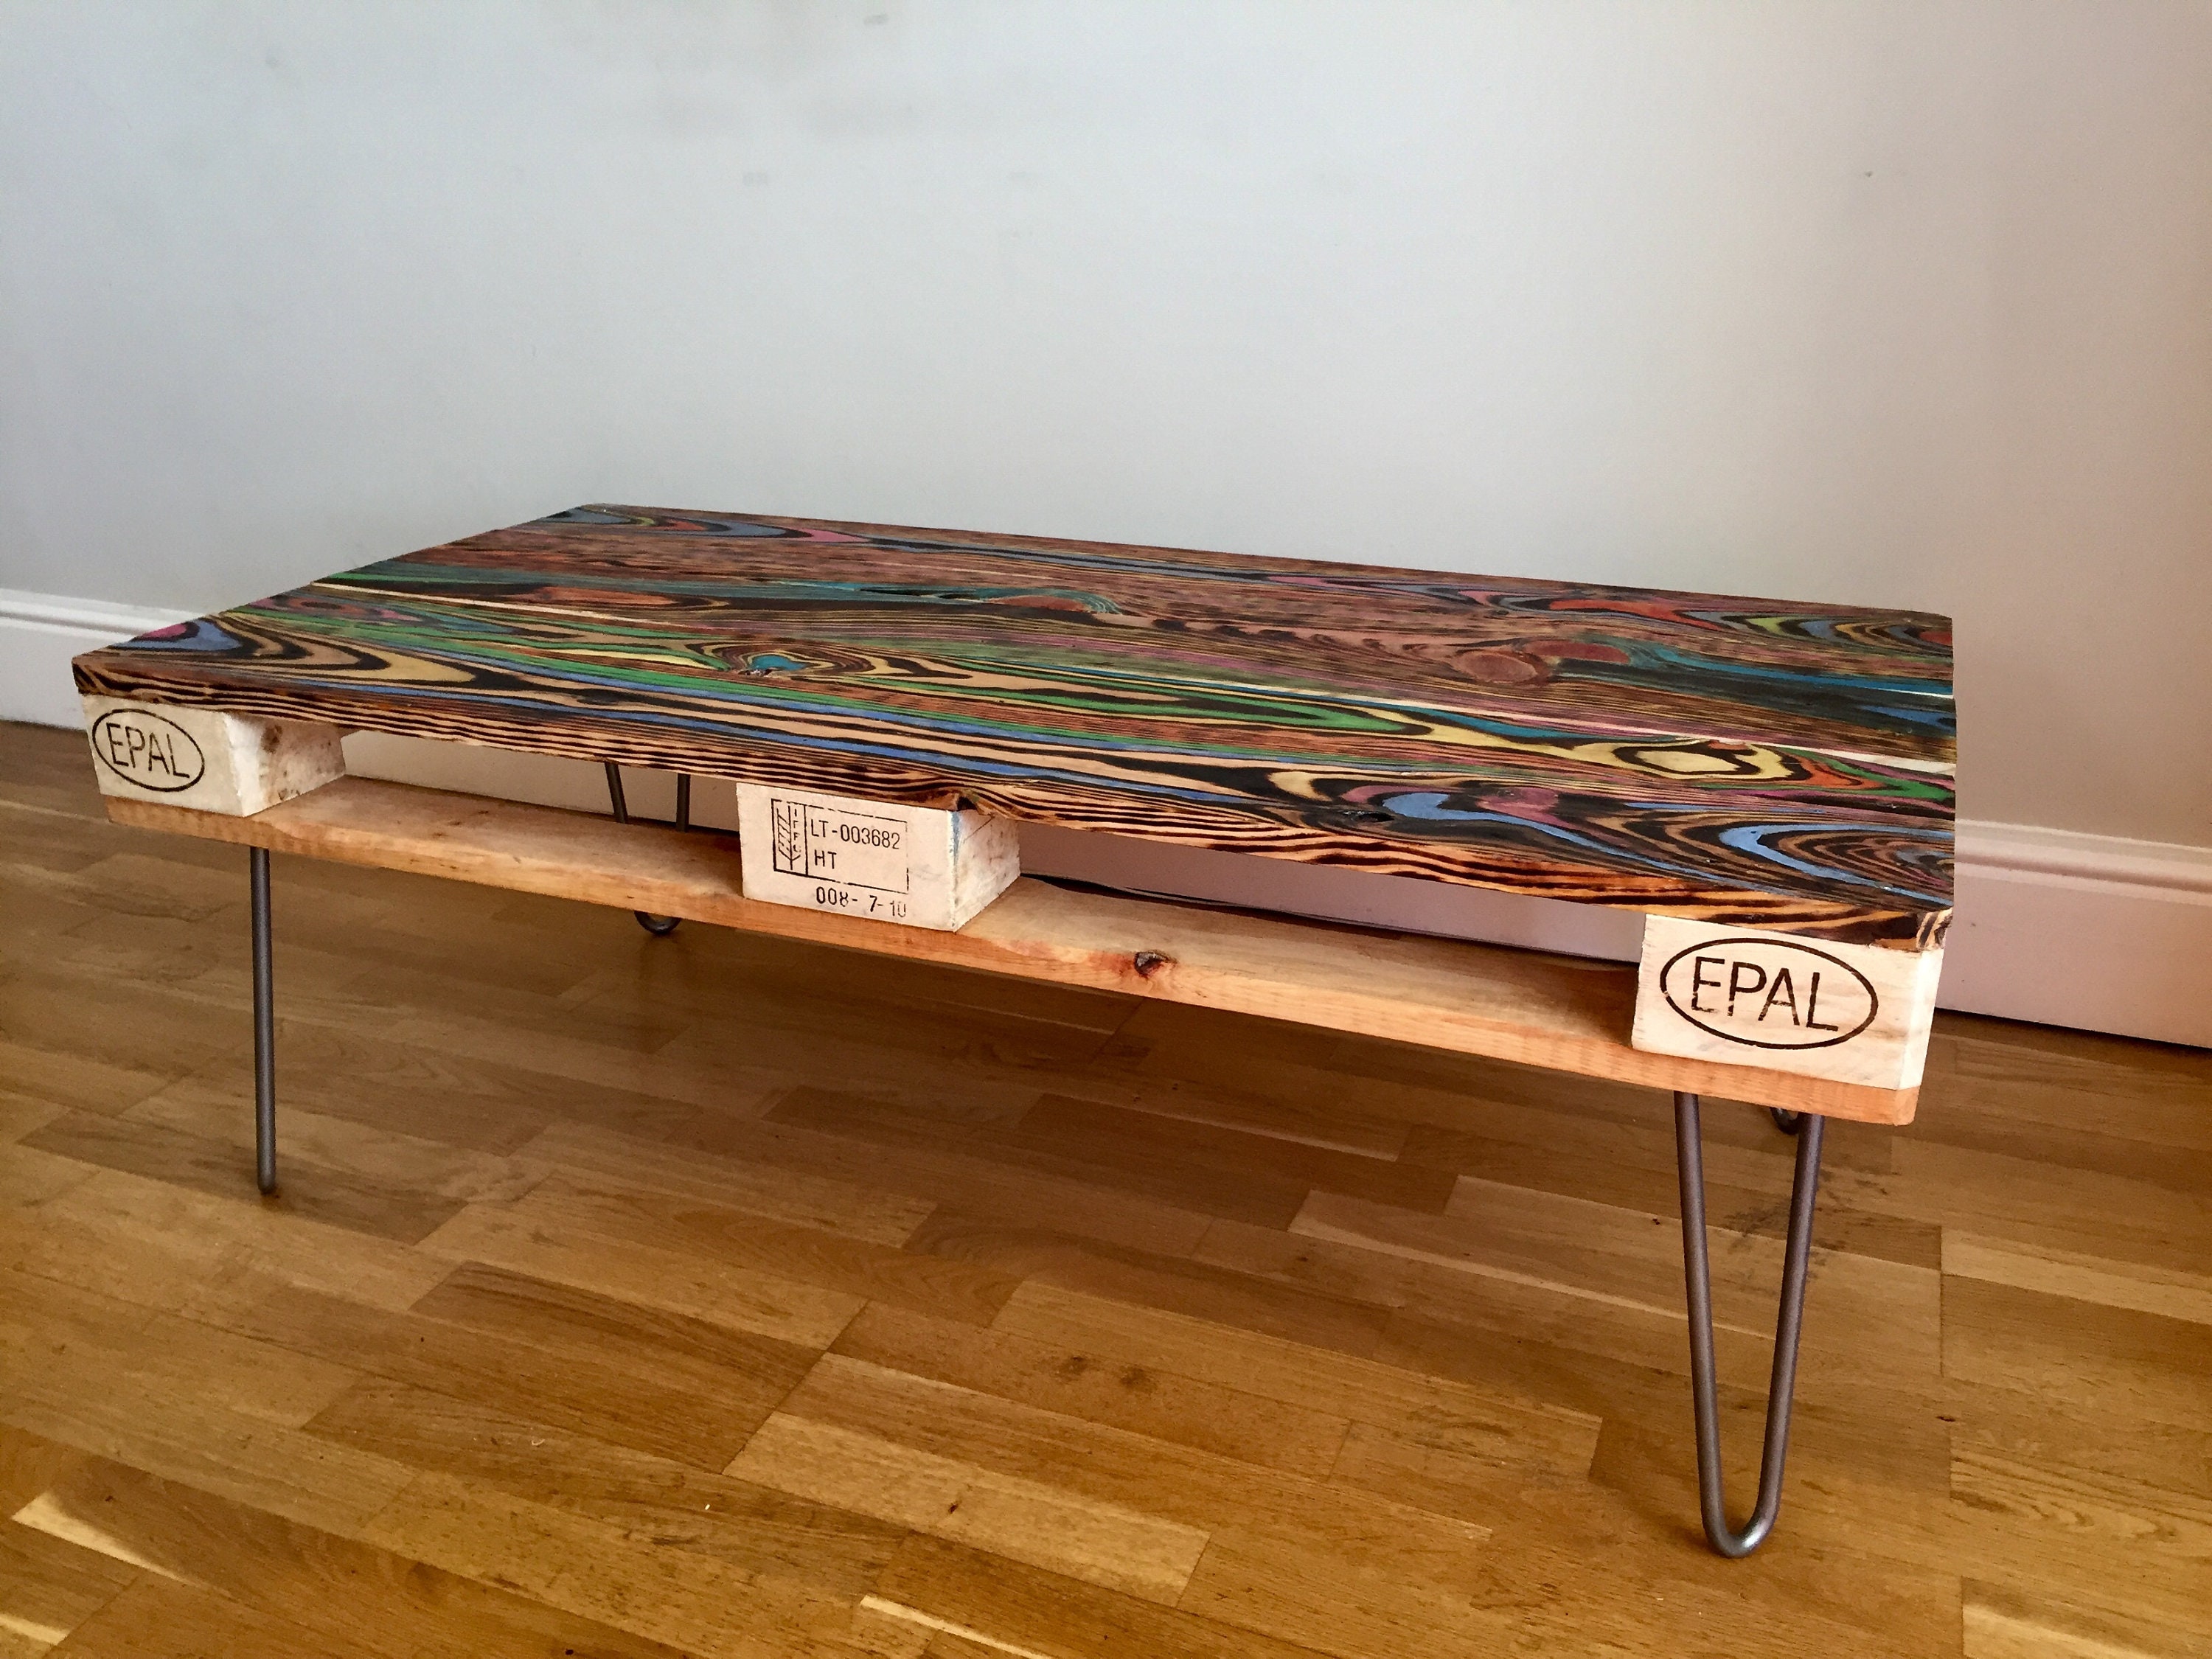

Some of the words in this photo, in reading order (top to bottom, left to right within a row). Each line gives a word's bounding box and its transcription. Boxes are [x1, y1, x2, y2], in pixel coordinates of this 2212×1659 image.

[106, 723, 190, 778] EPAL
[811, 818, 900, 849] LT-003682
[814, 849, 838, 869] HT
[1691, 956, 1839, 1032] EPAL
